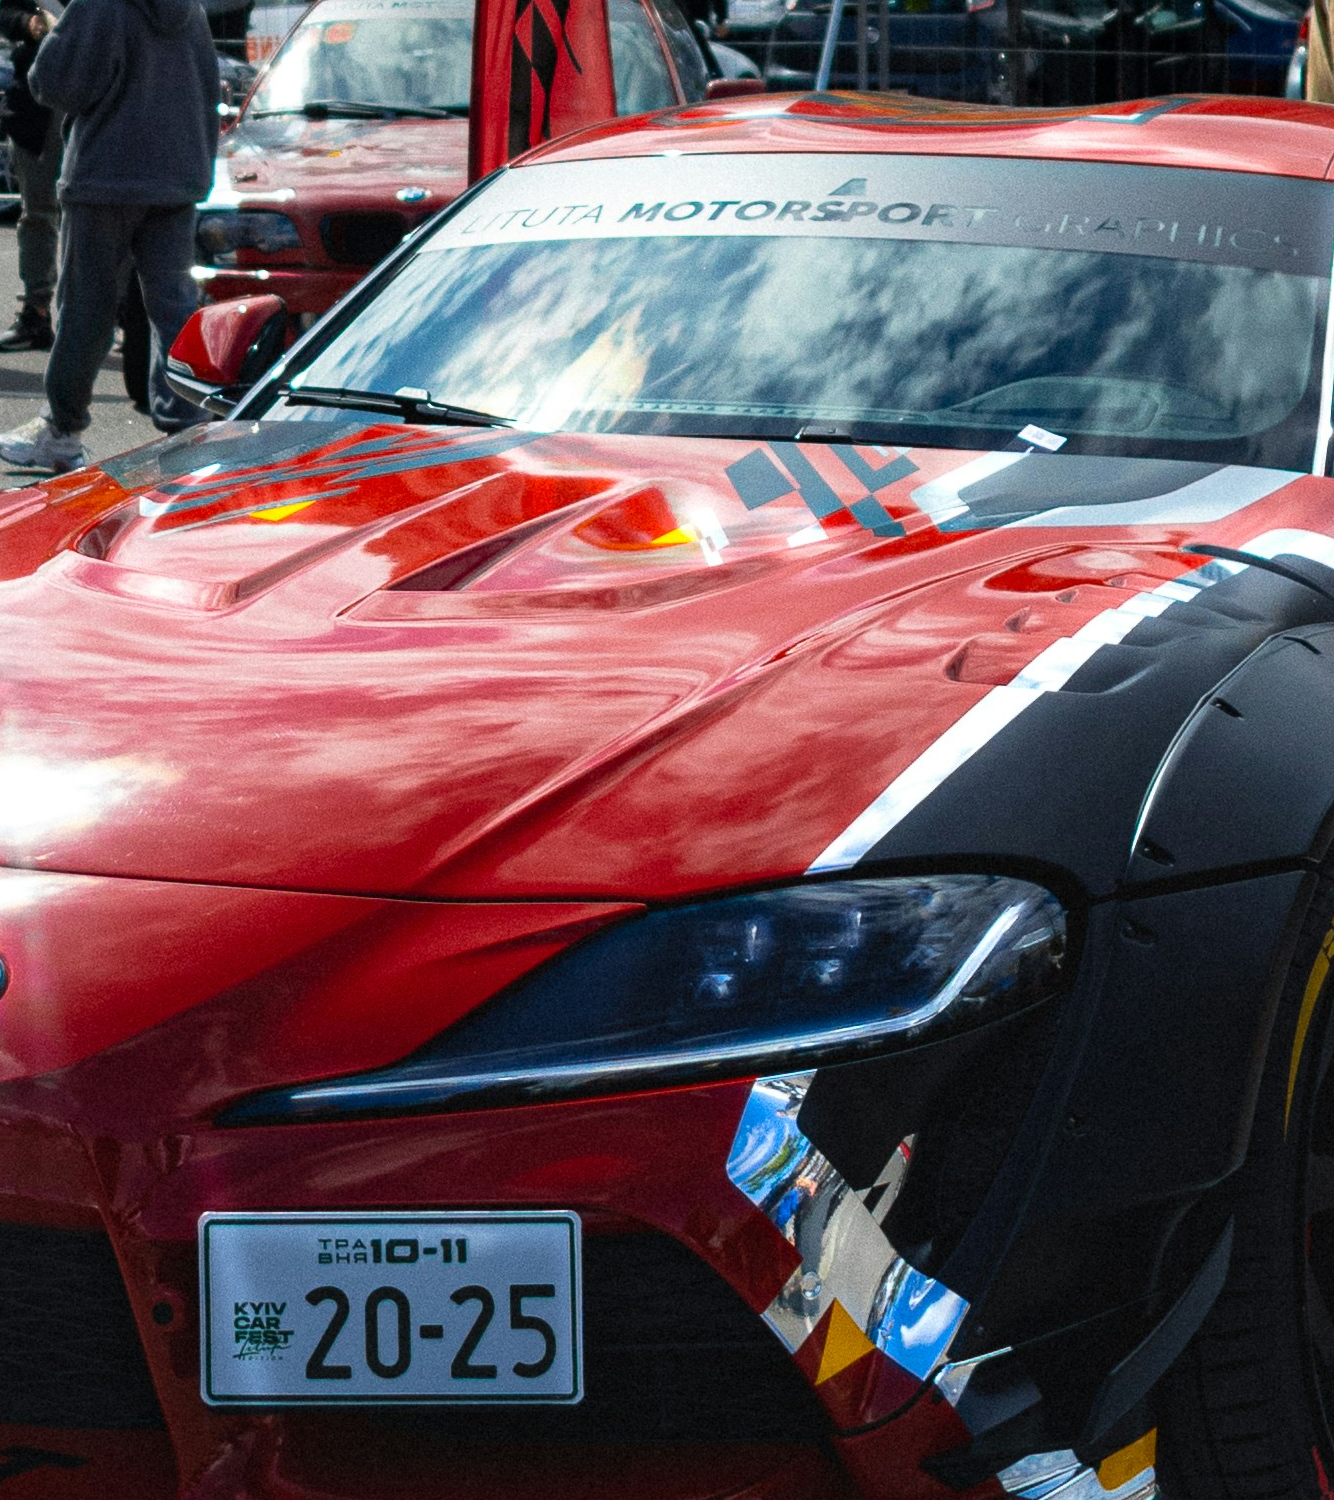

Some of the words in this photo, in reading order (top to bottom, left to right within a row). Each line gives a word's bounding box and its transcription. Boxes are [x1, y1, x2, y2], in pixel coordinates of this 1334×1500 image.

[460, 203, 605, 237] LITUTA
[616, 199, 1001, 230] MOTORSPORT
[1013, 213, 1301, 257] GRAPHICS
[318, 1238, 366, 1250] ТРА
[369, 1238, 468, 1264] 10-11
[318, 1251, 368, 1264] ВНЯ
[233, 1301, 287, 1316] KYIV
[233, 1316, 281, 1330] CAR
[234, 1330, 295, 1345] FEST
[304, 1284, 557, 1380] 20-25
